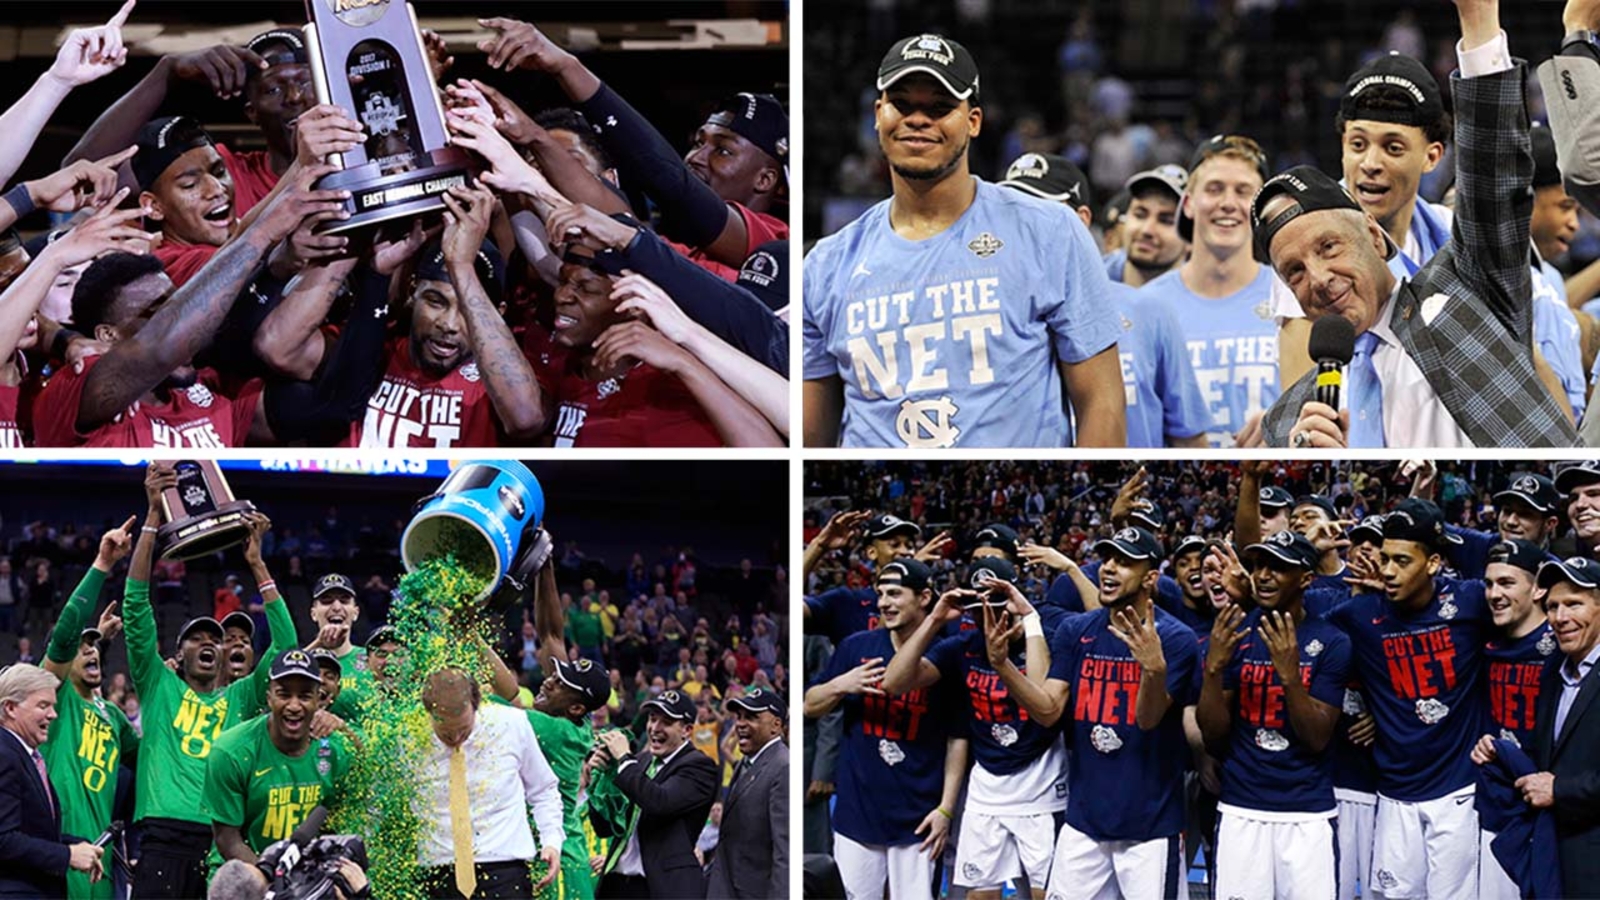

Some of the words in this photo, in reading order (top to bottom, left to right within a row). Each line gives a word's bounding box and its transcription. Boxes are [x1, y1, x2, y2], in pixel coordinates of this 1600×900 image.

[362, 192, 386, 208] EAST
[847, 292, 915, 335] CUT
[926, 277, 1001, 319] THE
[846, 314, 1003, 401] NET
[1215, 335, 1278, 367] THE
[368, 380, 421, 417] CUT
[420, 393, 463, 425] THE
[1195, 364, 1277, 427] ET
[555, 405, 588, 438] THE
[1382, 636, 1415, 659] CUT
[1417, 628, 1455, 653] THE
[965, 670, 1000, 689] CUT
[1081, 657, 1115, 680] CUT
[1240, 663, 1275, 686] CUT
[1387, 648, 1457, 699] NET
[1514, 663, 1543, 686] THE
[1074, 677, 1140, 726] NET
[1240, 685, 1286, 729] NE
[1490, 684, 1540, 731] NET
[269, 786, 294, 806] CUT
[298, 784, 322, 804] THE
